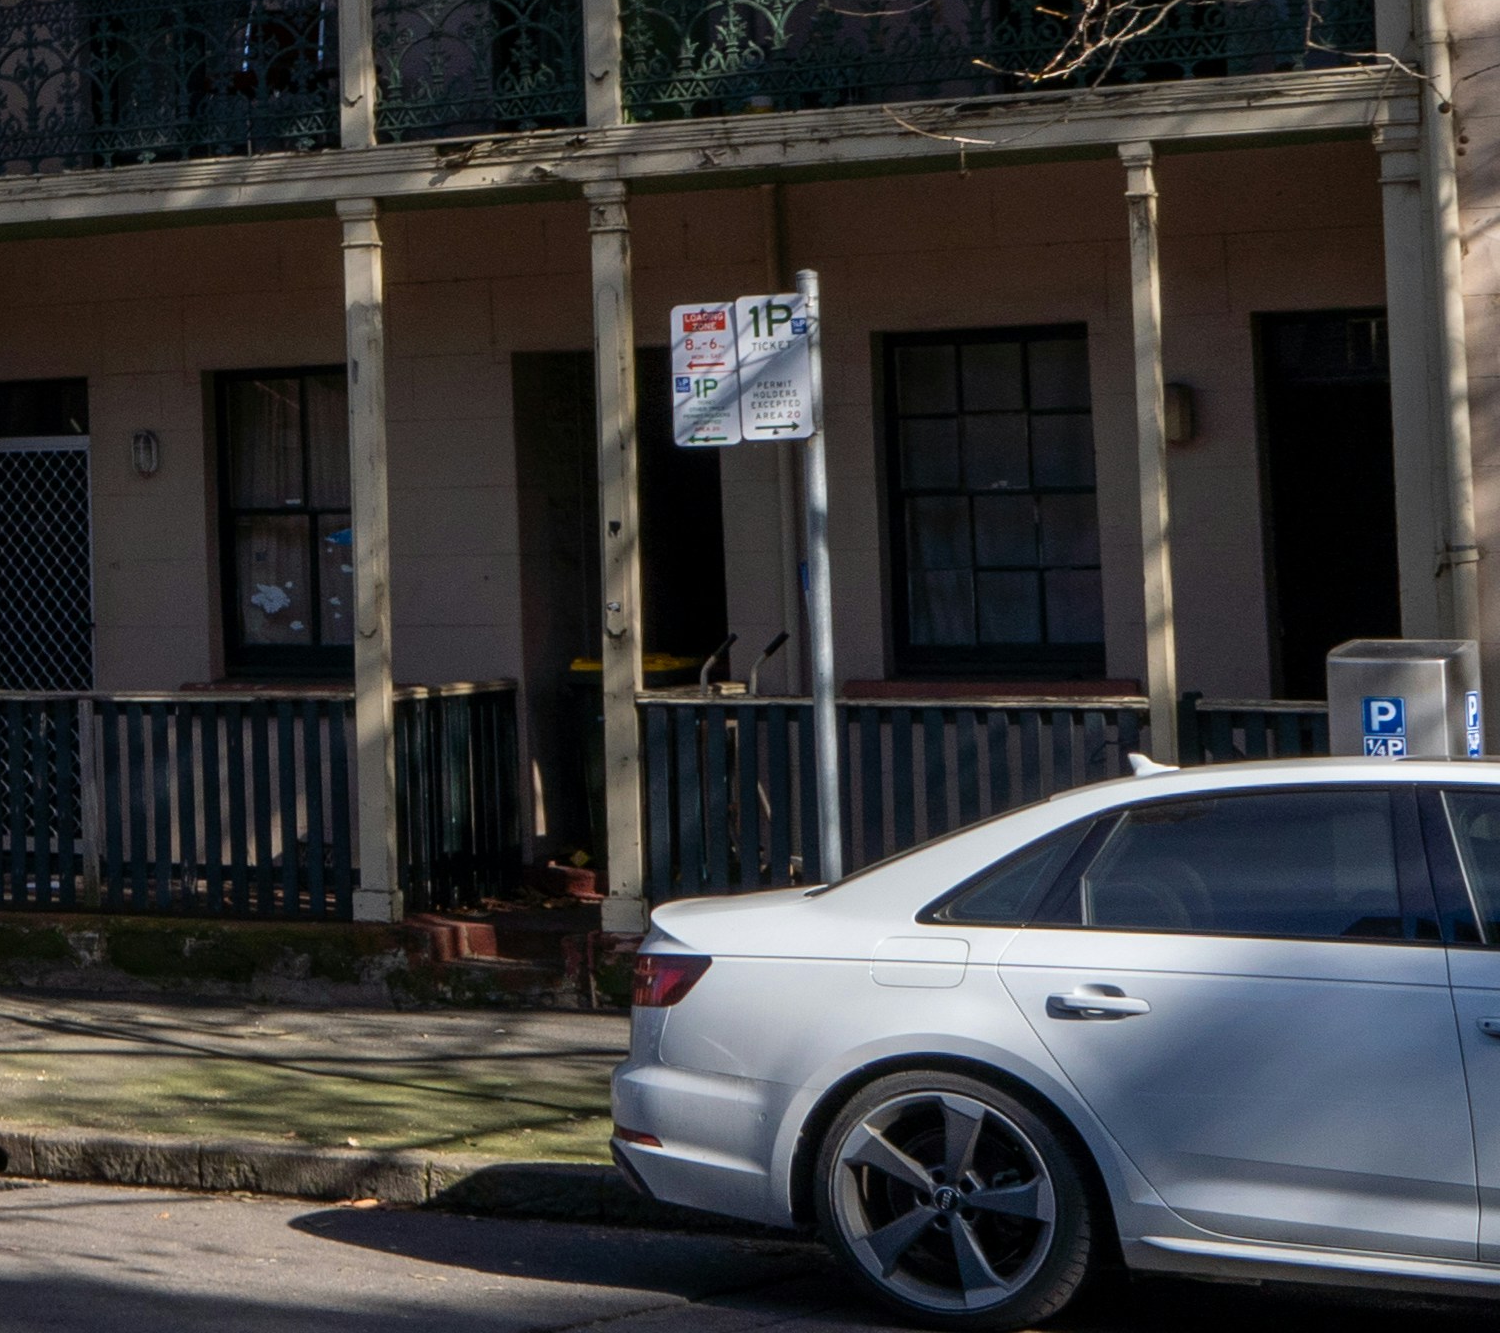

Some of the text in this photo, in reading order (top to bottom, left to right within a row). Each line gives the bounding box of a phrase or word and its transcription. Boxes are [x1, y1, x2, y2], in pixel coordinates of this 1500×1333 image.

[684, 312, 724, 323] LOADING
[748, 303, 793, 338] 1P
[691, 322, 717, 331] ZONE
[751, 340, 792, 351] TICKET
[694, 378, 718, 398] 1P
[756, 379, 793, 389] PERMIT
[752, 389, 798, 399] HOLDERS
[750, 399, 801, 410] EXCEPTED
[754, 409, 801, 420] AREA 20
[1370, 700, 1397, 732] P
